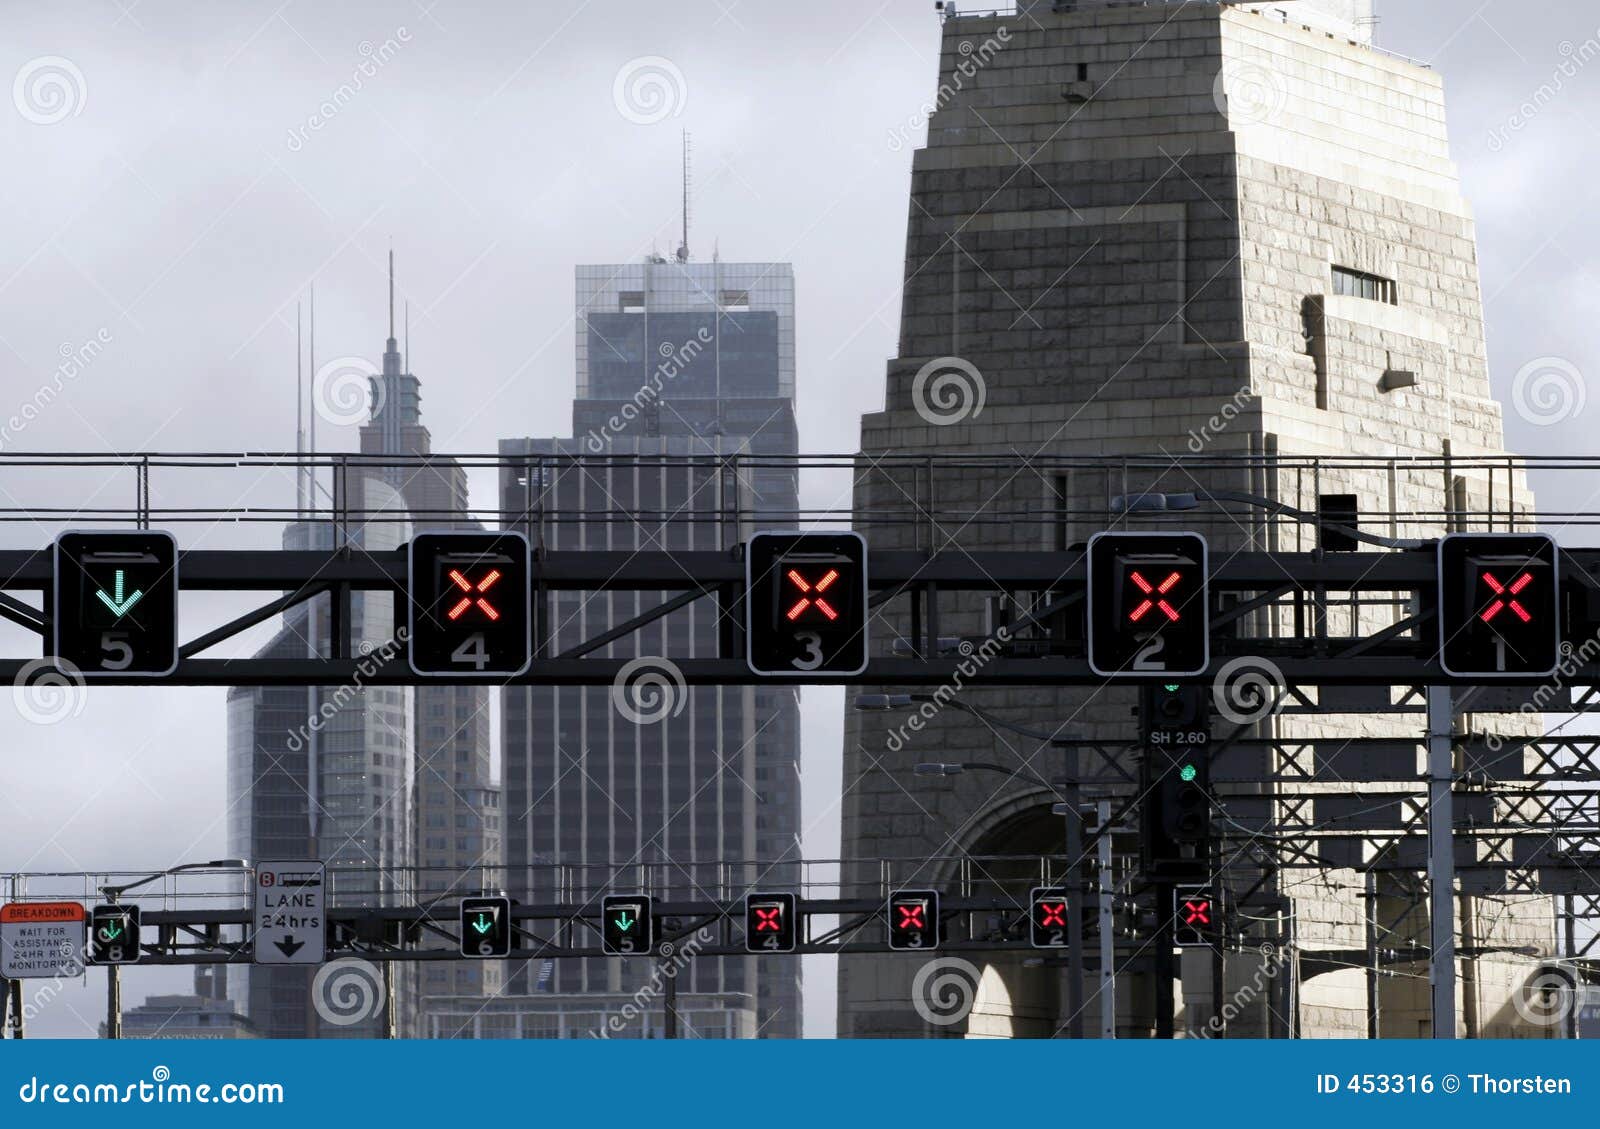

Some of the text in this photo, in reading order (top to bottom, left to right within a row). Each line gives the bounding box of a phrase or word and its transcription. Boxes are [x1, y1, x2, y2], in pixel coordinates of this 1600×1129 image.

[100, 631, 133, 670] 5
[451, 632, 490, 670] 4
[791, 631, 823, 670] 3
[1133, 632, 1165, 670] 2
[1491, 634, 1505, 671] 1
[1151, 732, 1206, 743] SH 2.60
[265, 894, 315, 907] LANE
[10, 908, 75, 918] BREAKDOWN
[262, 915, 319, 928] 24hrs
[20, 927, 65, 936] WAIT FOR
[1051, 930, 1065, 945] 2
[479, 939, 493, 954] 6
[620, 937, 634, 953] 5
[763, 936, 779, 950] 4
[908, 932, 922, 948] 3
[14, 950, 44, 959] 24HR
[109, 946, 123, 961] 8
